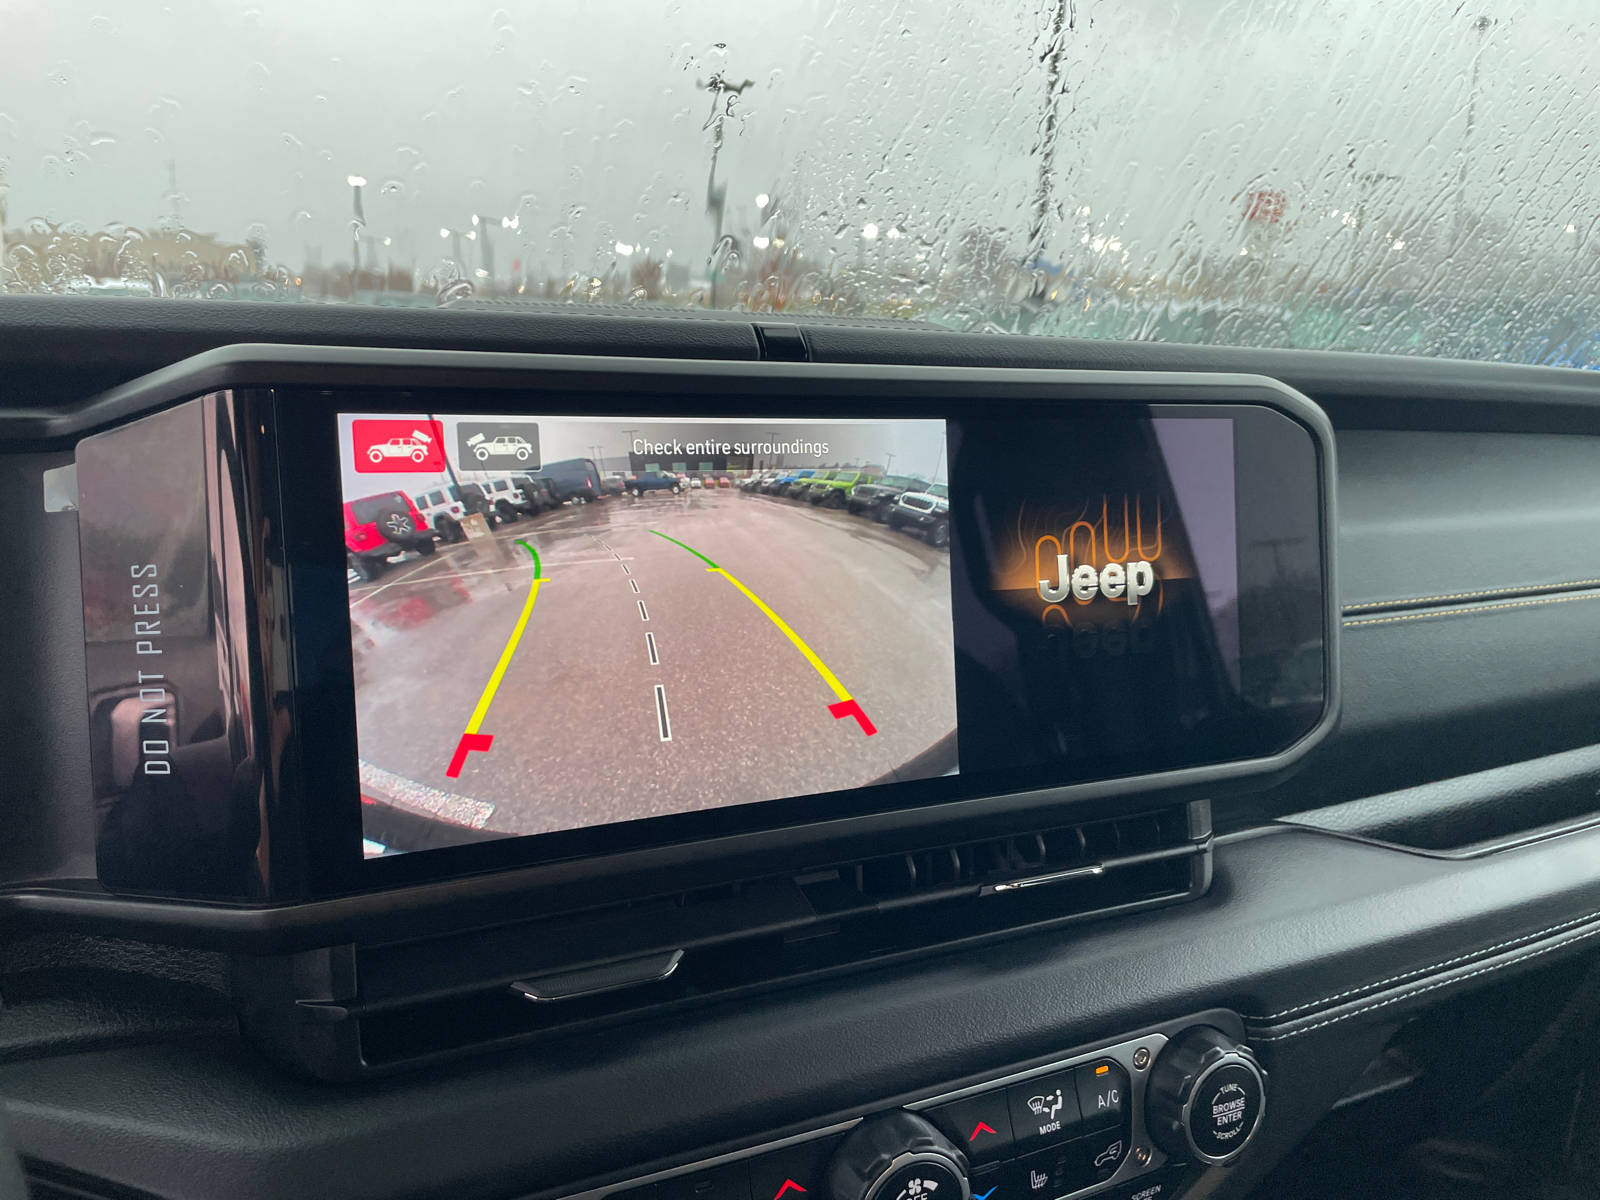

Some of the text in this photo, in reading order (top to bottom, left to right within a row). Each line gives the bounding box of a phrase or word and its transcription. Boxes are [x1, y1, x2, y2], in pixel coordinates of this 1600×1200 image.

[633, 439, 829, 458] Check entire surroundings
[1038, 553, 1155, 606] Jeep
[131, 563, 171, 775] DO NOT PRESS
[1220, 1083, 1239, 1095] TUNE
[1098, 1089, 1119, 1109] A/C
[1212, 1097, 1246, 1115] BROWSE
[1217, 1111, 1243, 1126] ENTER
[1039, 1121, 1061, 1135] MODE
[1216, 1126, 1241, 1140] SCROLL
[1131, 1184, 1162, 1200] SCREEN
